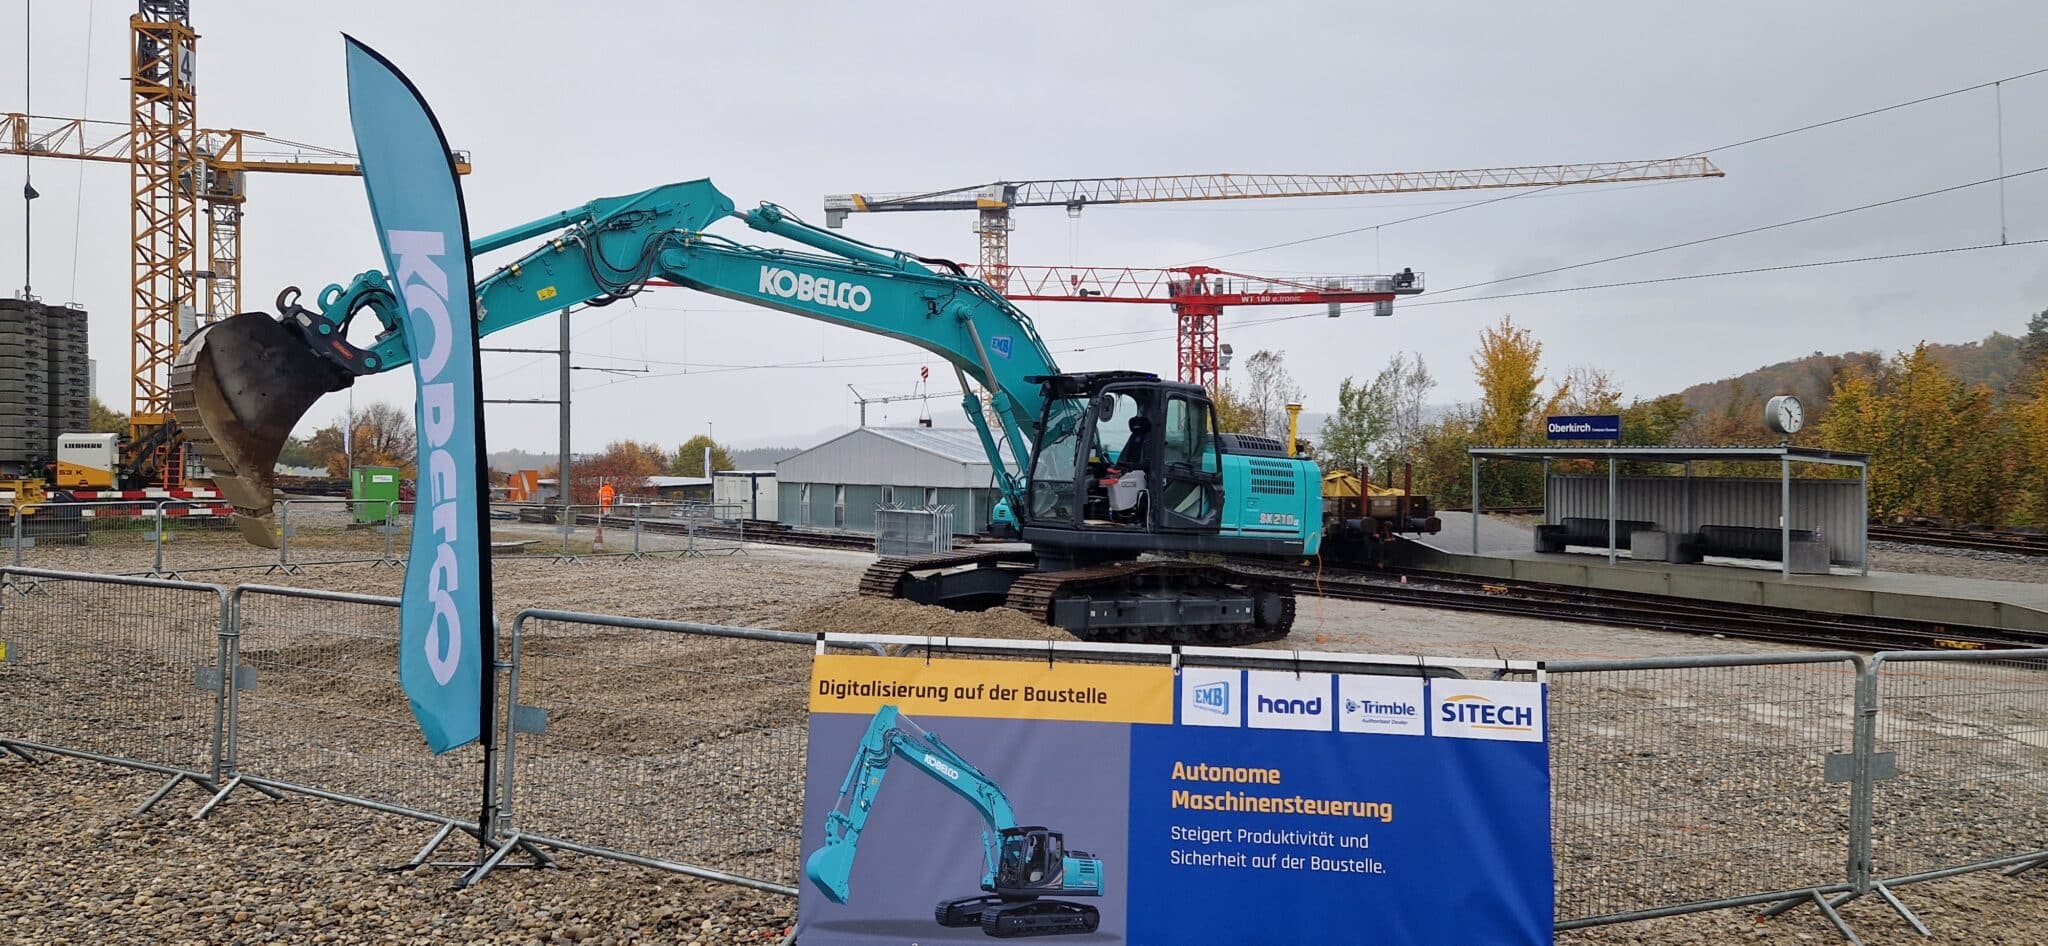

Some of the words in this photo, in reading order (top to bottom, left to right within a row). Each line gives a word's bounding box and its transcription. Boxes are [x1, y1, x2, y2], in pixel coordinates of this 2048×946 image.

[181, 51, 192, 82] 4
[759, 265, 871, 312] KOBELCO
[1548, 423, 1591, 433] Oberkirch
[819, 680, 948, 702] Digitalisierung
[954, 684, 984, 700] auf
[989, 684, 1018, 701] der
[1024, 686, 1107, 704] Baustelle
[1195, 688, 1223, 706] EMB
[1258, 695, 1322, 715] hand
[1361, 700, 1416, 716] Trimble
[1441, 702, 1533, 726] SITECH
[924, 753, 959, 780] KOBELCO
[1171, 761, 1281, 785] Autonome
[1171, 790, 1393, 823] Maschinensteuerung
[1171, 826, 1232, 844] Steigert
[1237, 828, 1335, 847] Produktivität
[1340, 834, 1369, 849] und
[1170, 850, 1247, 868] Sicherheit
[1252, 853, 1277, 869] auf
[1281, 854, 1306, 870] der
[1311, 856, 1386, 874] Baustelle.
